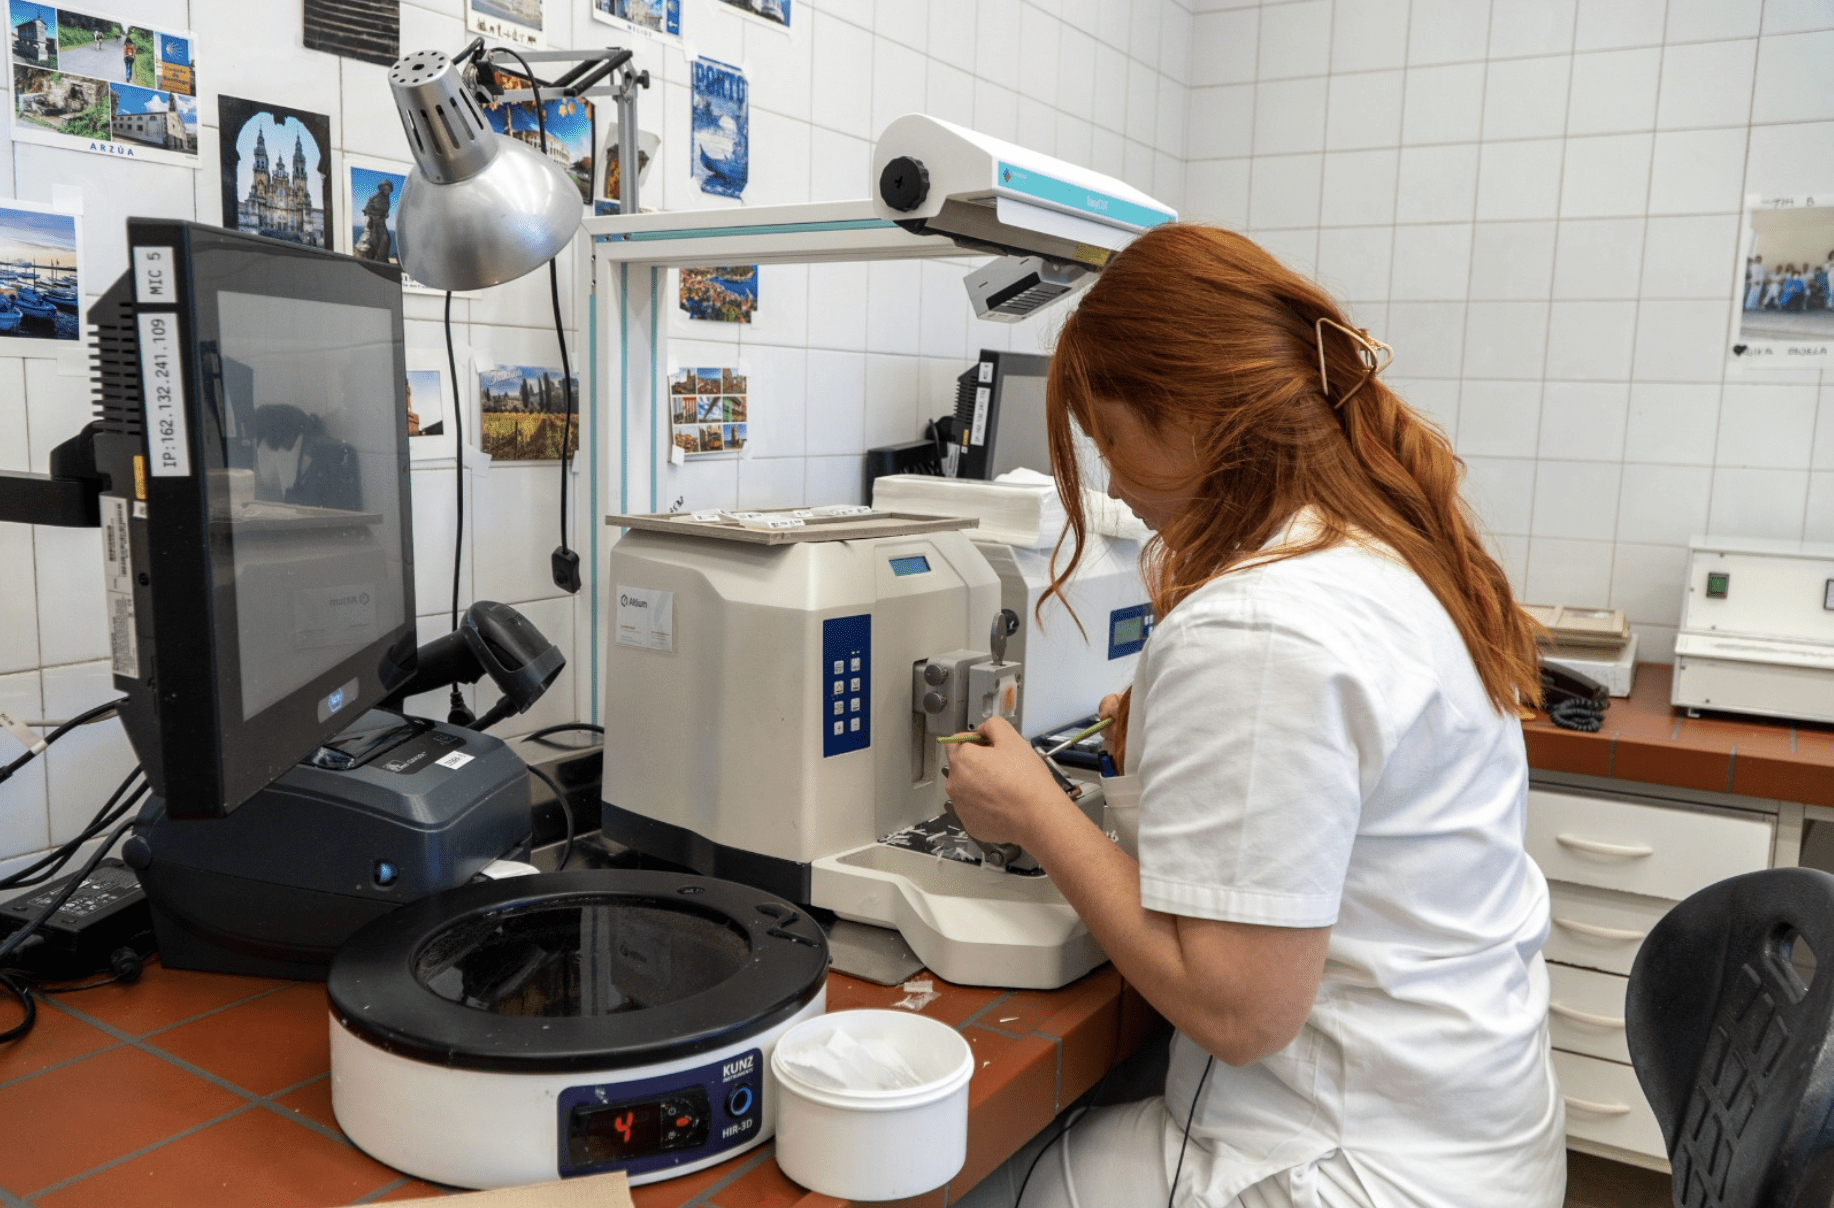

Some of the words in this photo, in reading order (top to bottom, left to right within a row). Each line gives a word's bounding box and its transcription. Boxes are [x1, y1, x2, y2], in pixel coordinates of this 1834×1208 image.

[89, 141, 134, 156] ARZÚA
[146, 252, 161, 261] 5
[147, 269, 164, 295] MIC
[151, 317, 177, 468] IP:162.132.241.109
[722, 1054, 754, 1077] KUNZ
[614, 1112, 634, 1143] 4
[722, 1118, 753, 1139] HIR-3D
